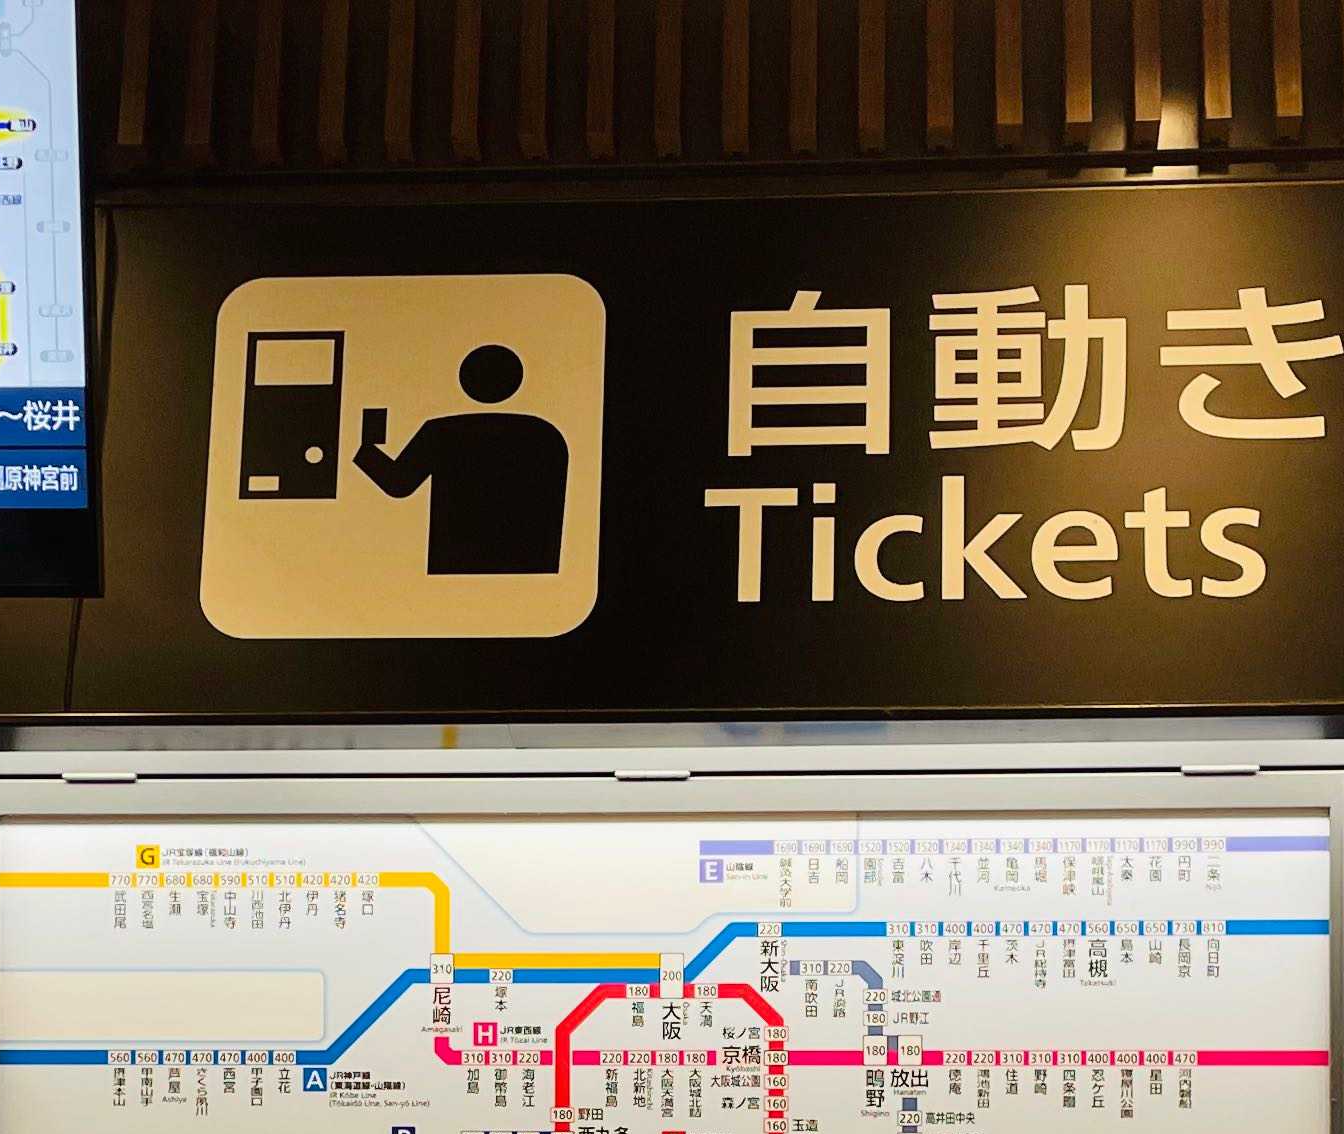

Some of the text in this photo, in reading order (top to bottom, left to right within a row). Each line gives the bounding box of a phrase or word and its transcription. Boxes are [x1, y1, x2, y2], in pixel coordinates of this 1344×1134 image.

[704, 475, 1267, 602] Tickets
[760, 941, 779, 993] 新大阪
[1088, 940, 1108, 977] 高槻
[432, 987, 451, 1025] 尼崎
[662, 1002, 681, 1040] 大阪
[722, 1046, 761, 1064] 京橋
[890, 1069, 929, 1089] 放出
